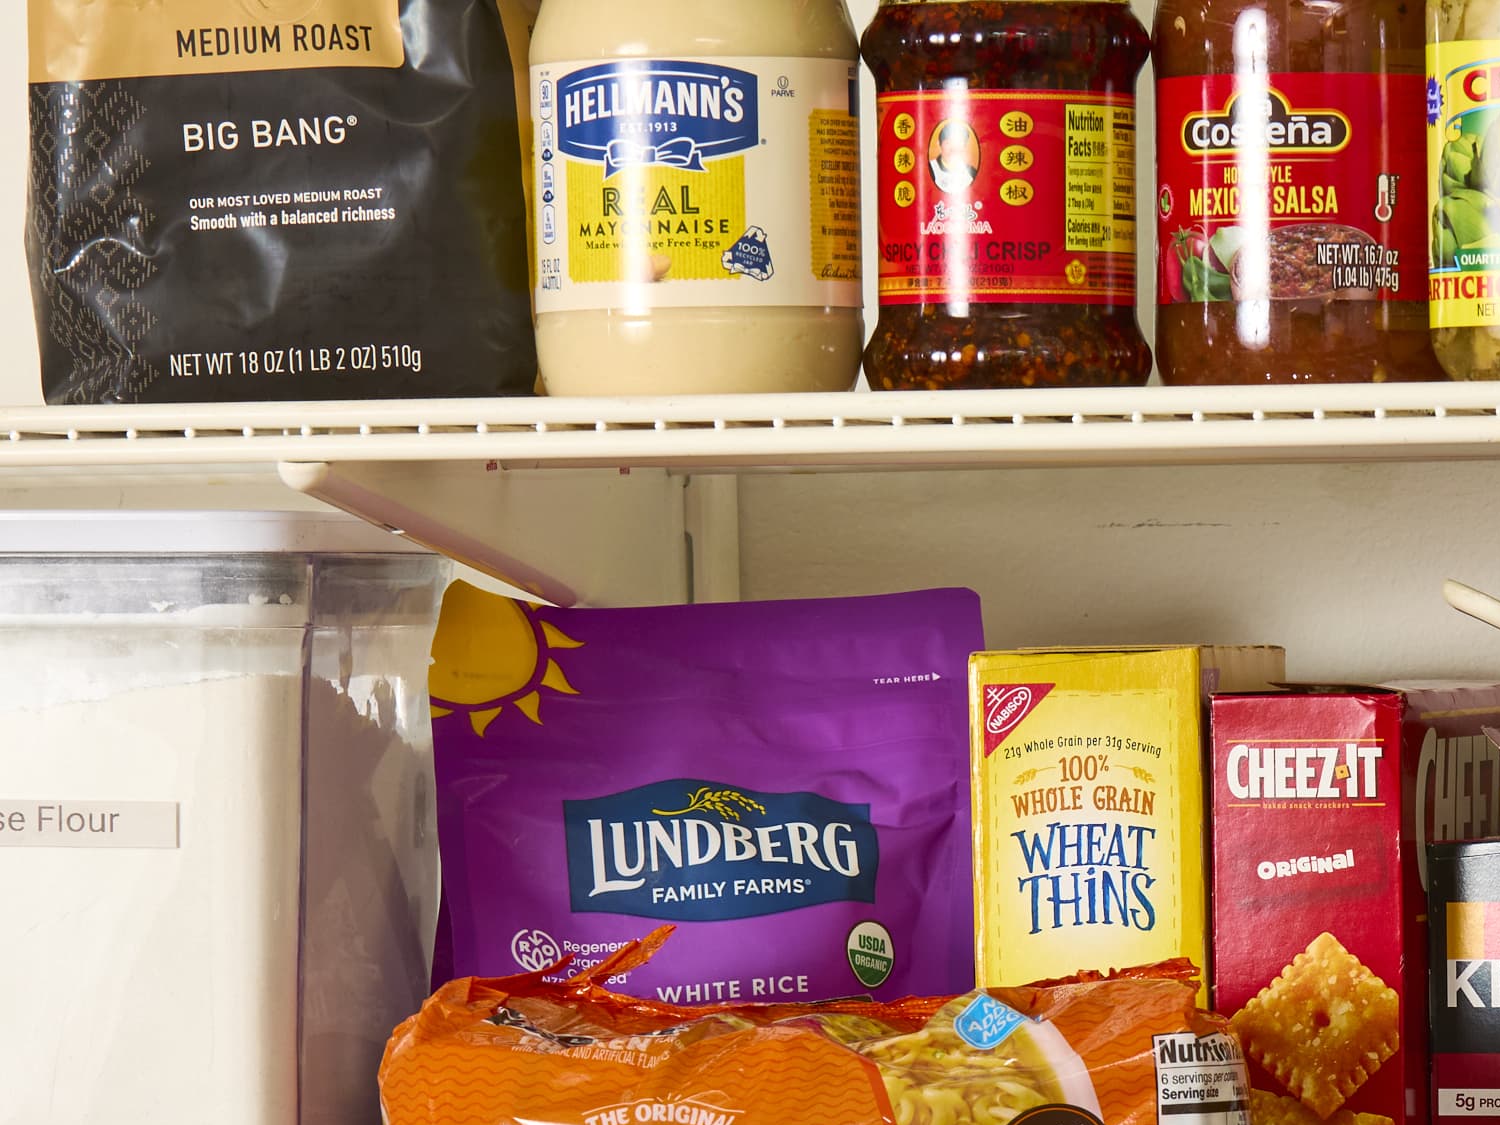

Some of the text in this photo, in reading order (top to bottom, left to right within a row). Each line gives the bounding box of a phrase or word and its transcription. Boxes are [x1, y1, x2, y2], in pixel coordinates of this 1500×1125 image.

[176, 24, 372, 58] MEDIUM ROAST
[565, 77, 744, 127] HELLMANN'S
[771, 89, 795, 97] PARVE
[1068, 112, 1103, 132] Nutrition
[183, 122, 238, 151] BIG
[189, 188, 382, 209] OUR MOST LOVED MEDIUM ROAST
[1274, 186, 1338, 214] SALSA
[190, 205, 395, 231] Smooth with a balanced richness
[987, 242, 1049, 261] CRISP
[1333, 268, 1398, 291] (1.04 lb) 475g
[874, 677, 900, 685] TEAR
[989, 689, 1029, 731] NABISCO
[1004, 735, 1161, 759] 21g Whole Grain per 31g Serving
[1058, 755, 1109, 782] 100%
[1011, 786, 1155, 818] WHOLE GRAIN
[38, 805, 120, 832] Flour
[588, 819, 859, 897] LUNDBERG
[1011, 823, 1155, 871] WHEAT
[652, 881, 726, 904] FAMILY
[859, 934, 886, 954] USDA
[855, 955, 887, 971] ORGANIC
[657, 975, 809, 1003] WHITE RICE
